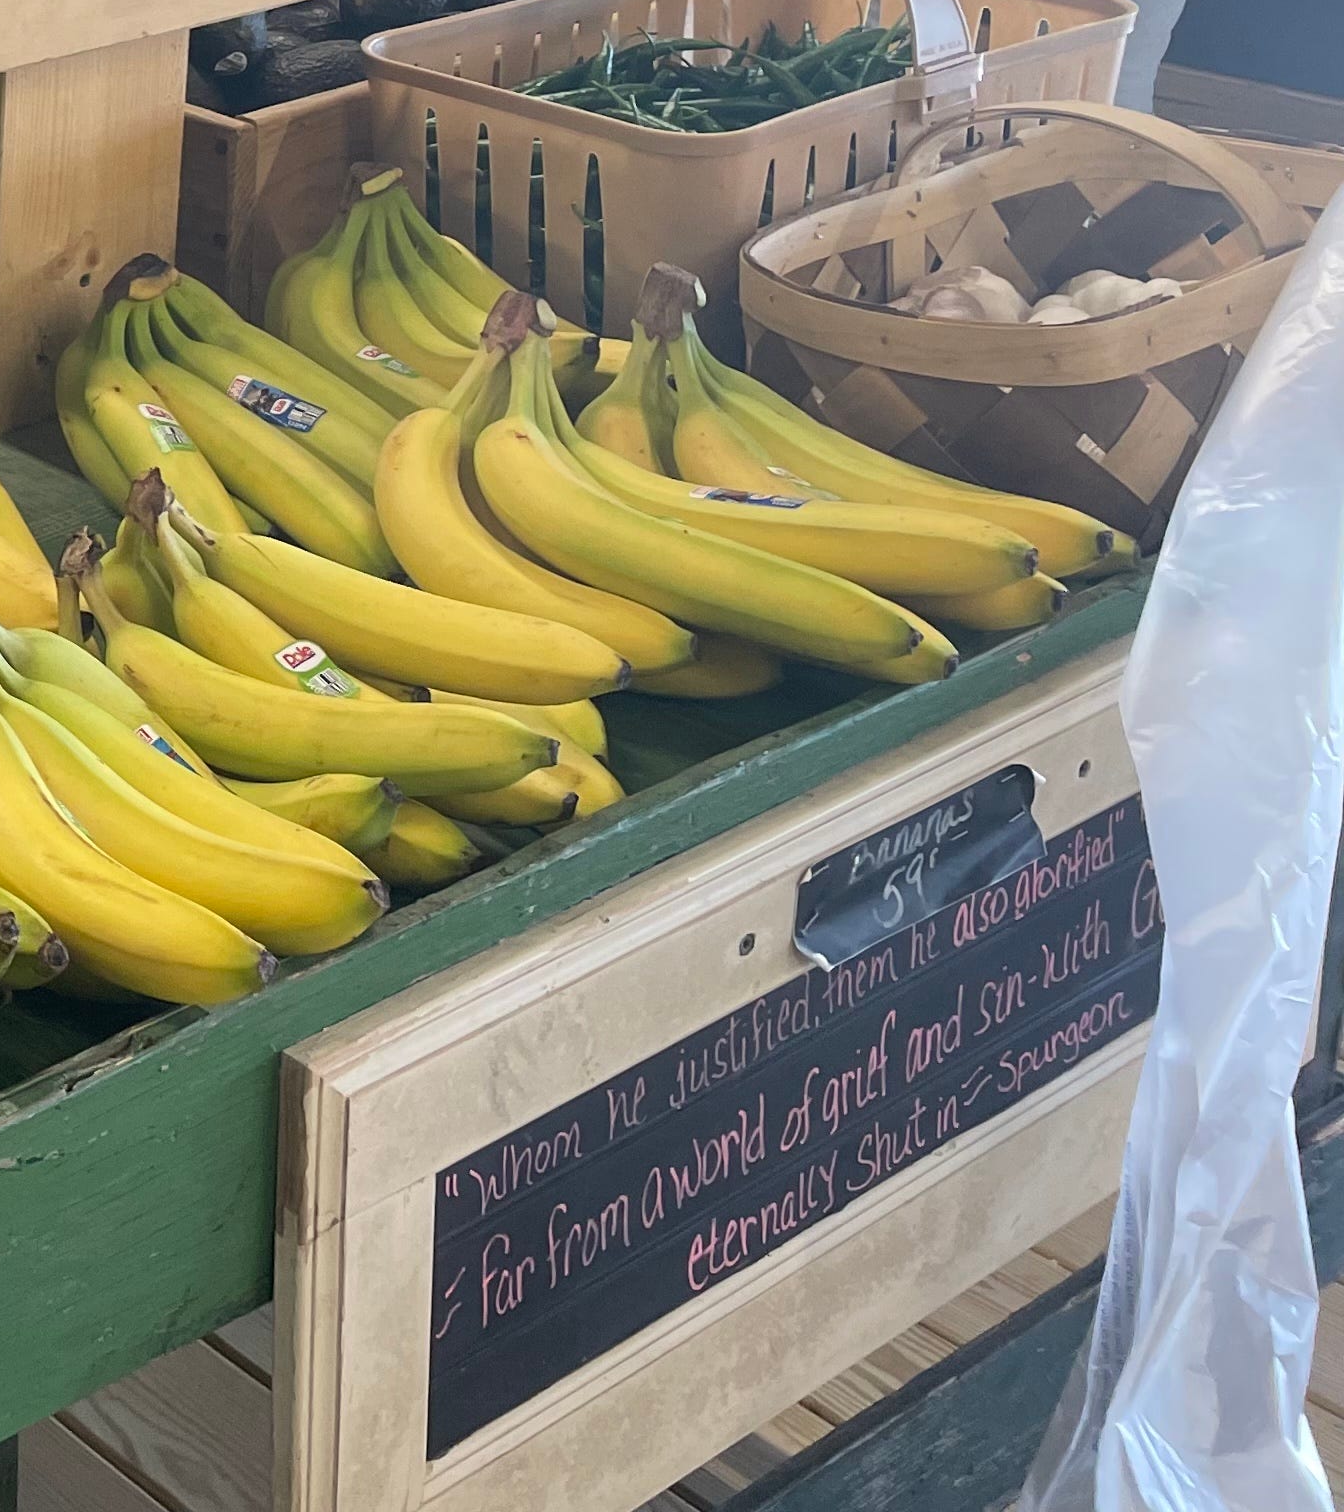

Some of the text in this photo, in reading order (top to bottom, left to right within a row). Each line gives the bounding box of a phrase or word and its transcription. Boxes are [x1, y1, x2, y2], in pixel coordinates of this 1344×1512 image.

[283, 646, 316, 669] Dole
[607, 1077, 647, 1140] he
[822, 945, 898, 1014] them
[910, 922, 940, 969] he
[953, 888, 1009, 948] also
[686, 1148, 840, 1292] eternally
[936, 1095, 960, 1139] in
[997, 990, 1133, 1093] Spurgeon
[482, 1234, 535, 1329] far
[547, 1202, 631, 1289] from
[641, 1166, 665, 1230] a
[779, 1066, 820, 1153] of
[822, 1009, 897, 1135] grief
[906, 984, 964, 1083] and
